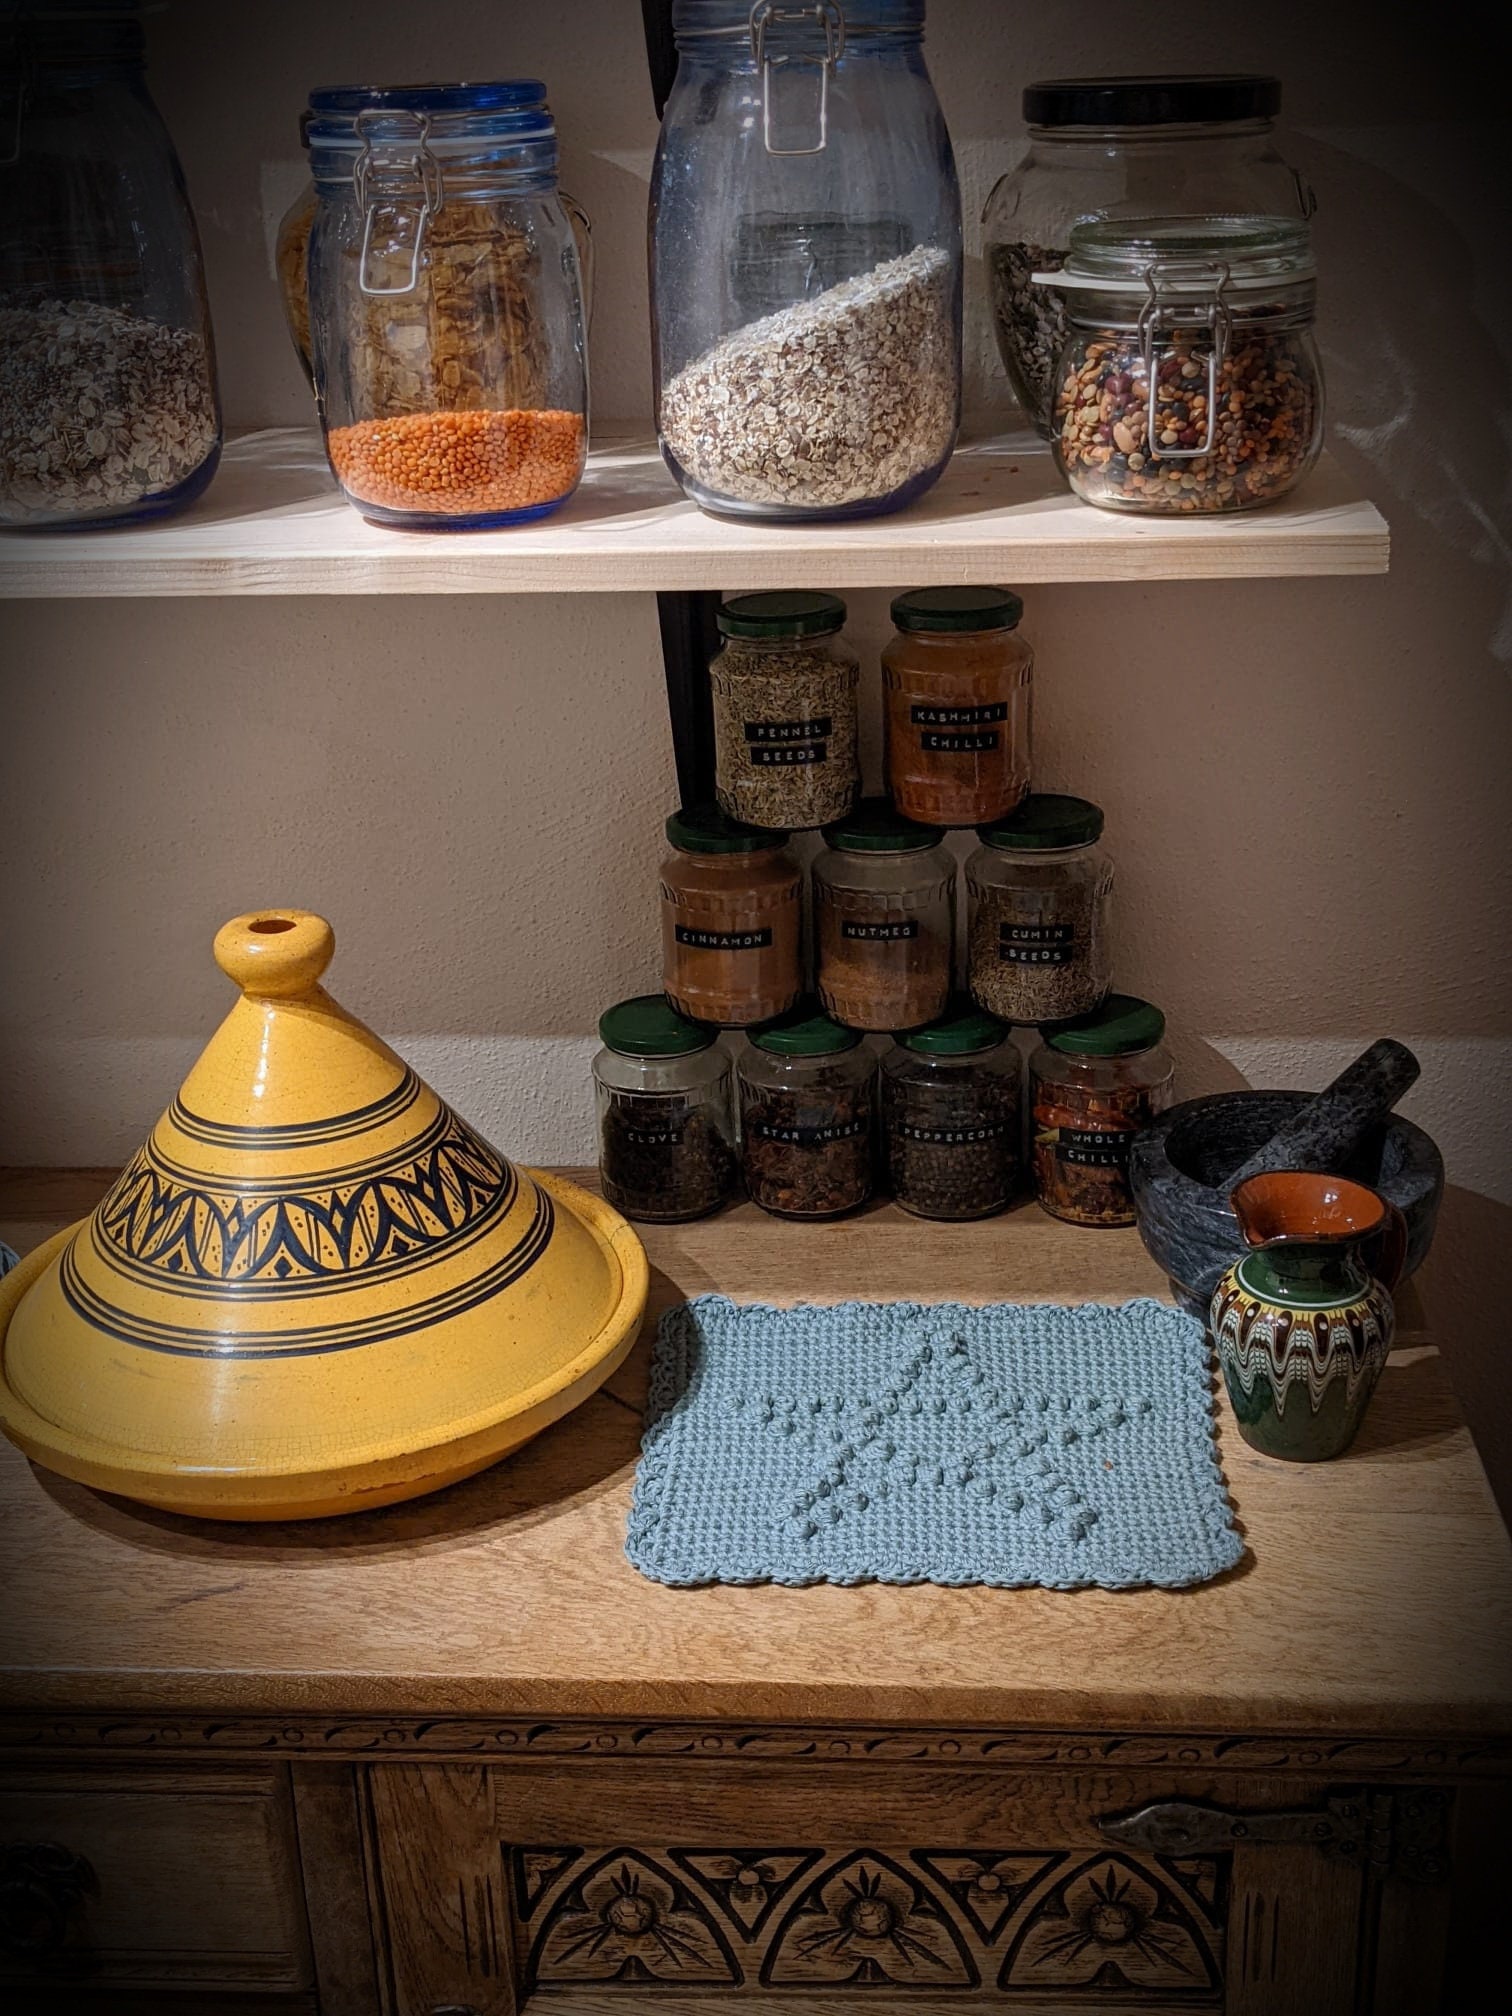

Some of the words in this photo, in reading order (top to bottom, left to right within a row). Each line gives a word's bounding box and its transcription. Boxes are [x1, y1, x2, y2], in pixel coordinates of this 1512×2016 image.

[917, 707, 1001, 722] KASHMIRI
[757, 724, 821, 738] FENNEL
[930, 736, 993, 748] CHILLI
[762, 750, 816, 761] SEEDS
[847, 927, 911, 937] NUTMEG
[1011, 930, 1063, 939] CUMIN
[682, 932, 762, 945] CINNAMON
[1009, 948, 1062, 961] SEEDS
[763, 1126, 800, 1140] STAR
[814, 1122, 860, 1140] ANISE
[627, 1132, 677, 1144] CLOVE
[1071, 1134, 1125, 1144] WHOLE
